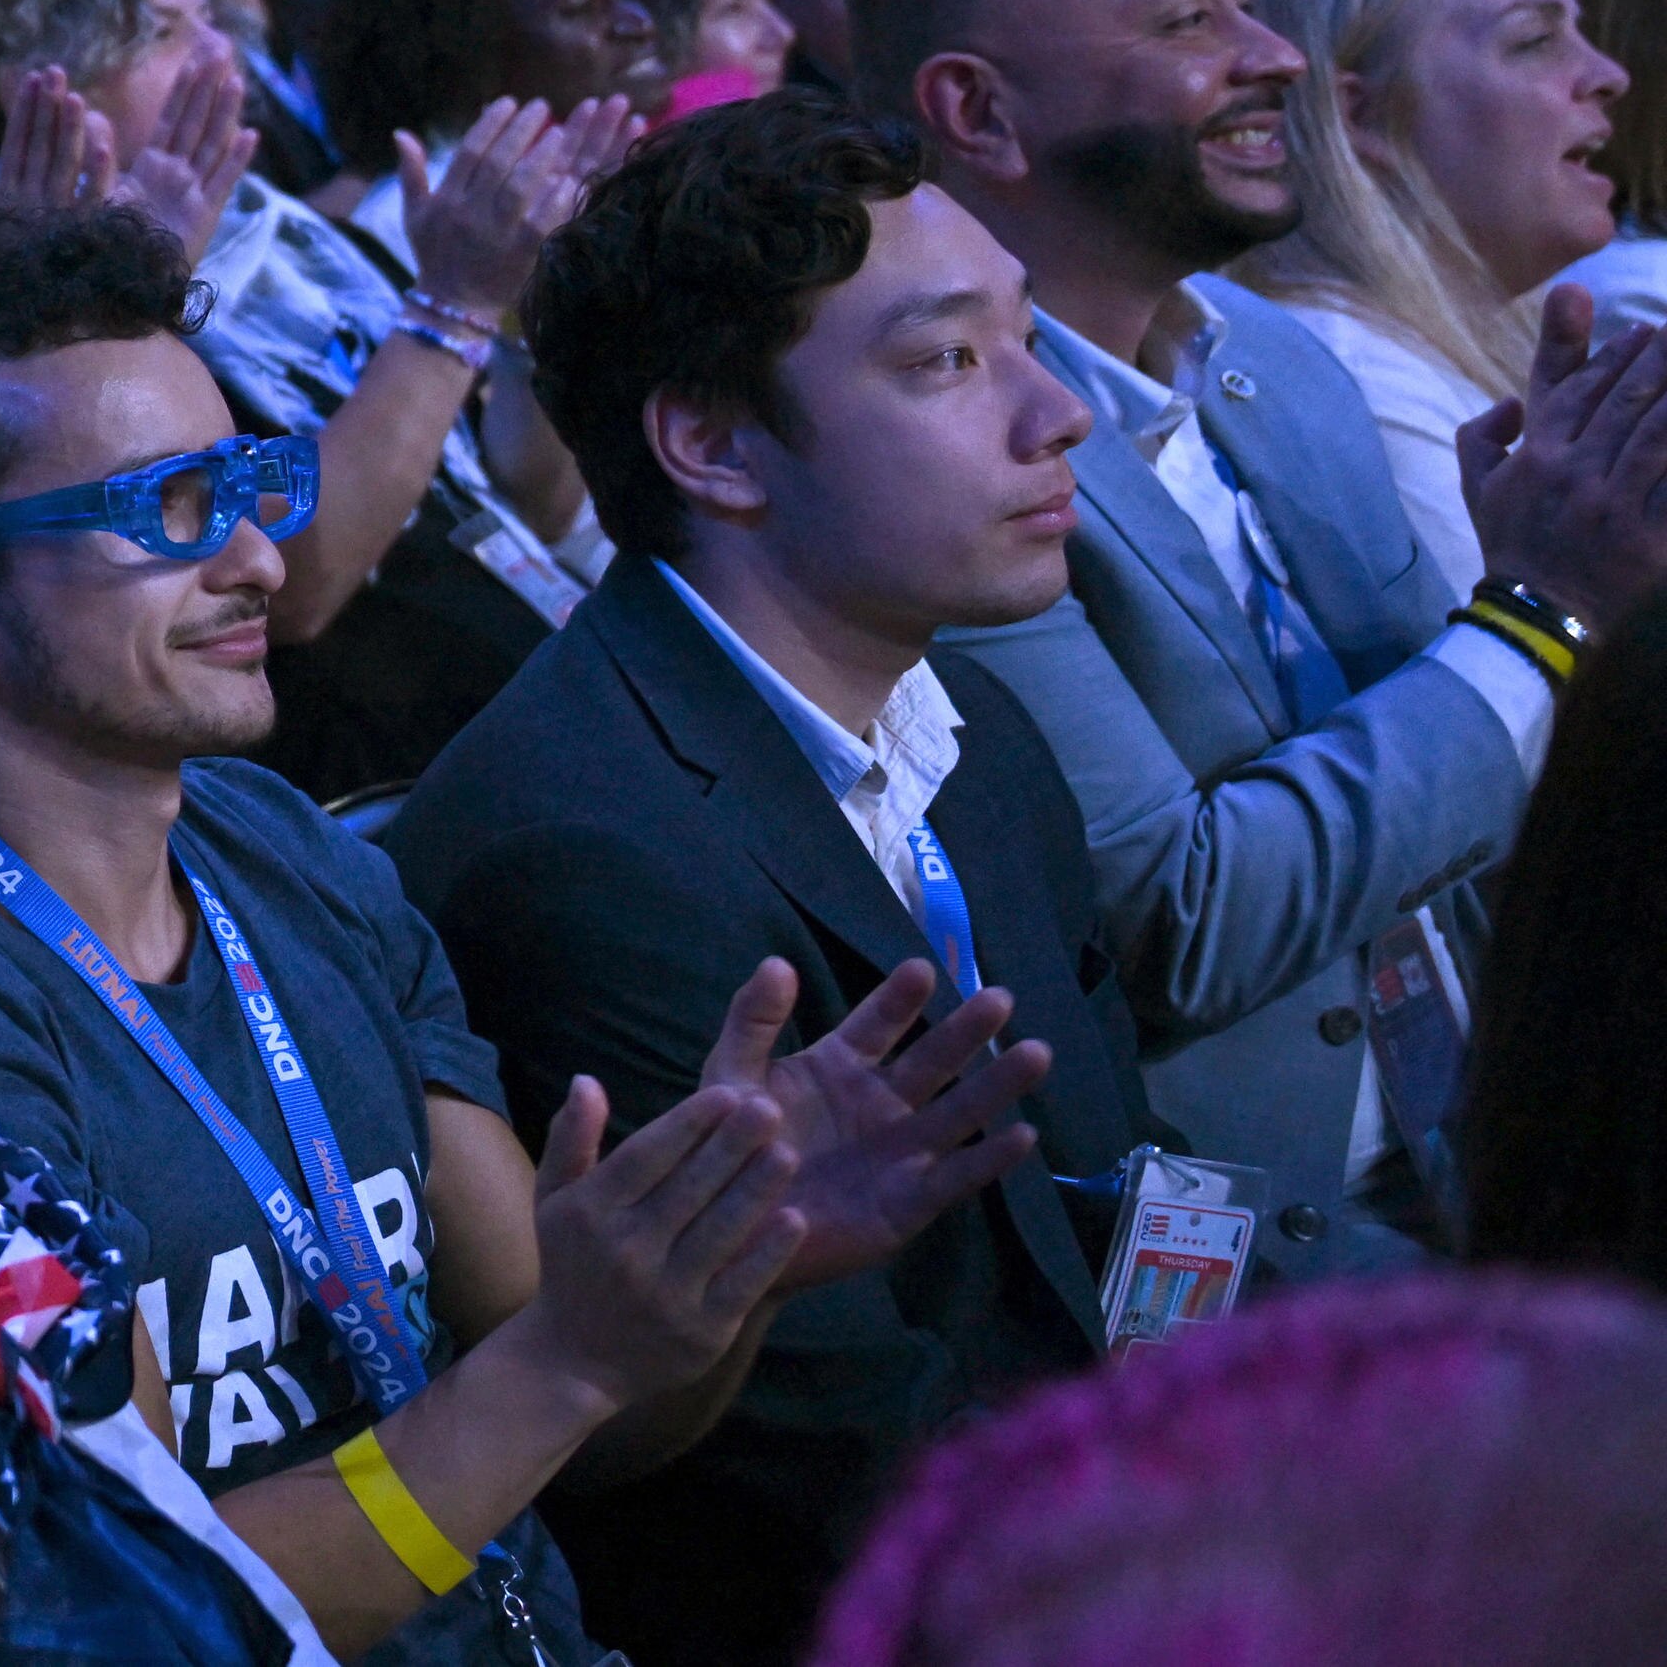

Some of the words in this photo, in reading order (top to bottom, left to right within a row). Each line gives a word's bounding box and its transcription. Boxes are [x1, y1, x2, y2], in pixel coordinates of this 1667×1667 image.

[912, 816, 949, 882] DN
[248, 994, 303, 1082] DNC
[267, 1188, 331, 1281] DNC
[331, 1303, 408, 1405] 2024
[1158, 1254, 1212, 1271] THURSDAY
